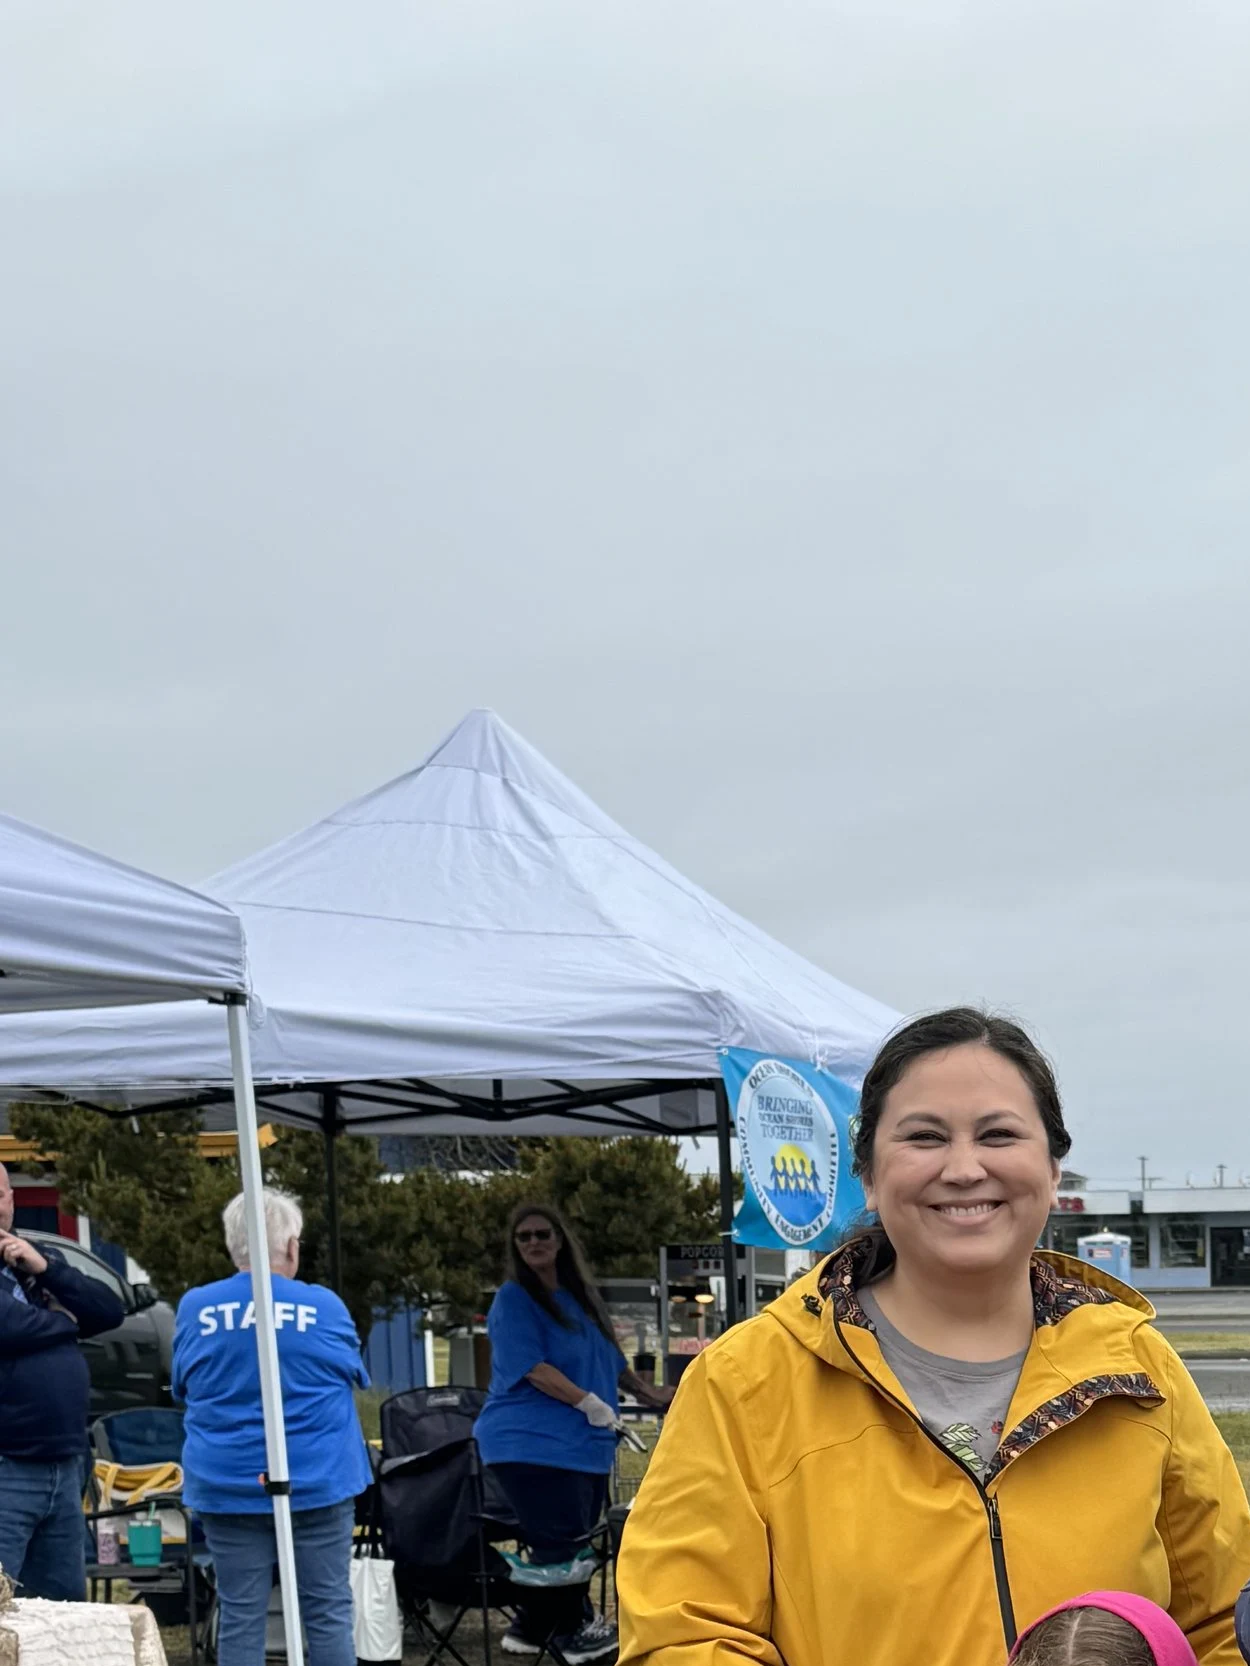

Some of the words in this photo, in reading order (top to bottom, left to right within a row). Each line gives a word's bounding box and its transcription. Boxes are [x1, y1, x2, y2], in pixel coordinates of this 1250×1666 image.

[757, 1095, 813, 1116] BRINGING
[758, 1112, 784, 1125] OCEAN
[760, 1123, 813, 1142] TOGETHER
[680, 1246, 725, 1258] POPCOR
[198, 1301, 317, 1336] STAFF
